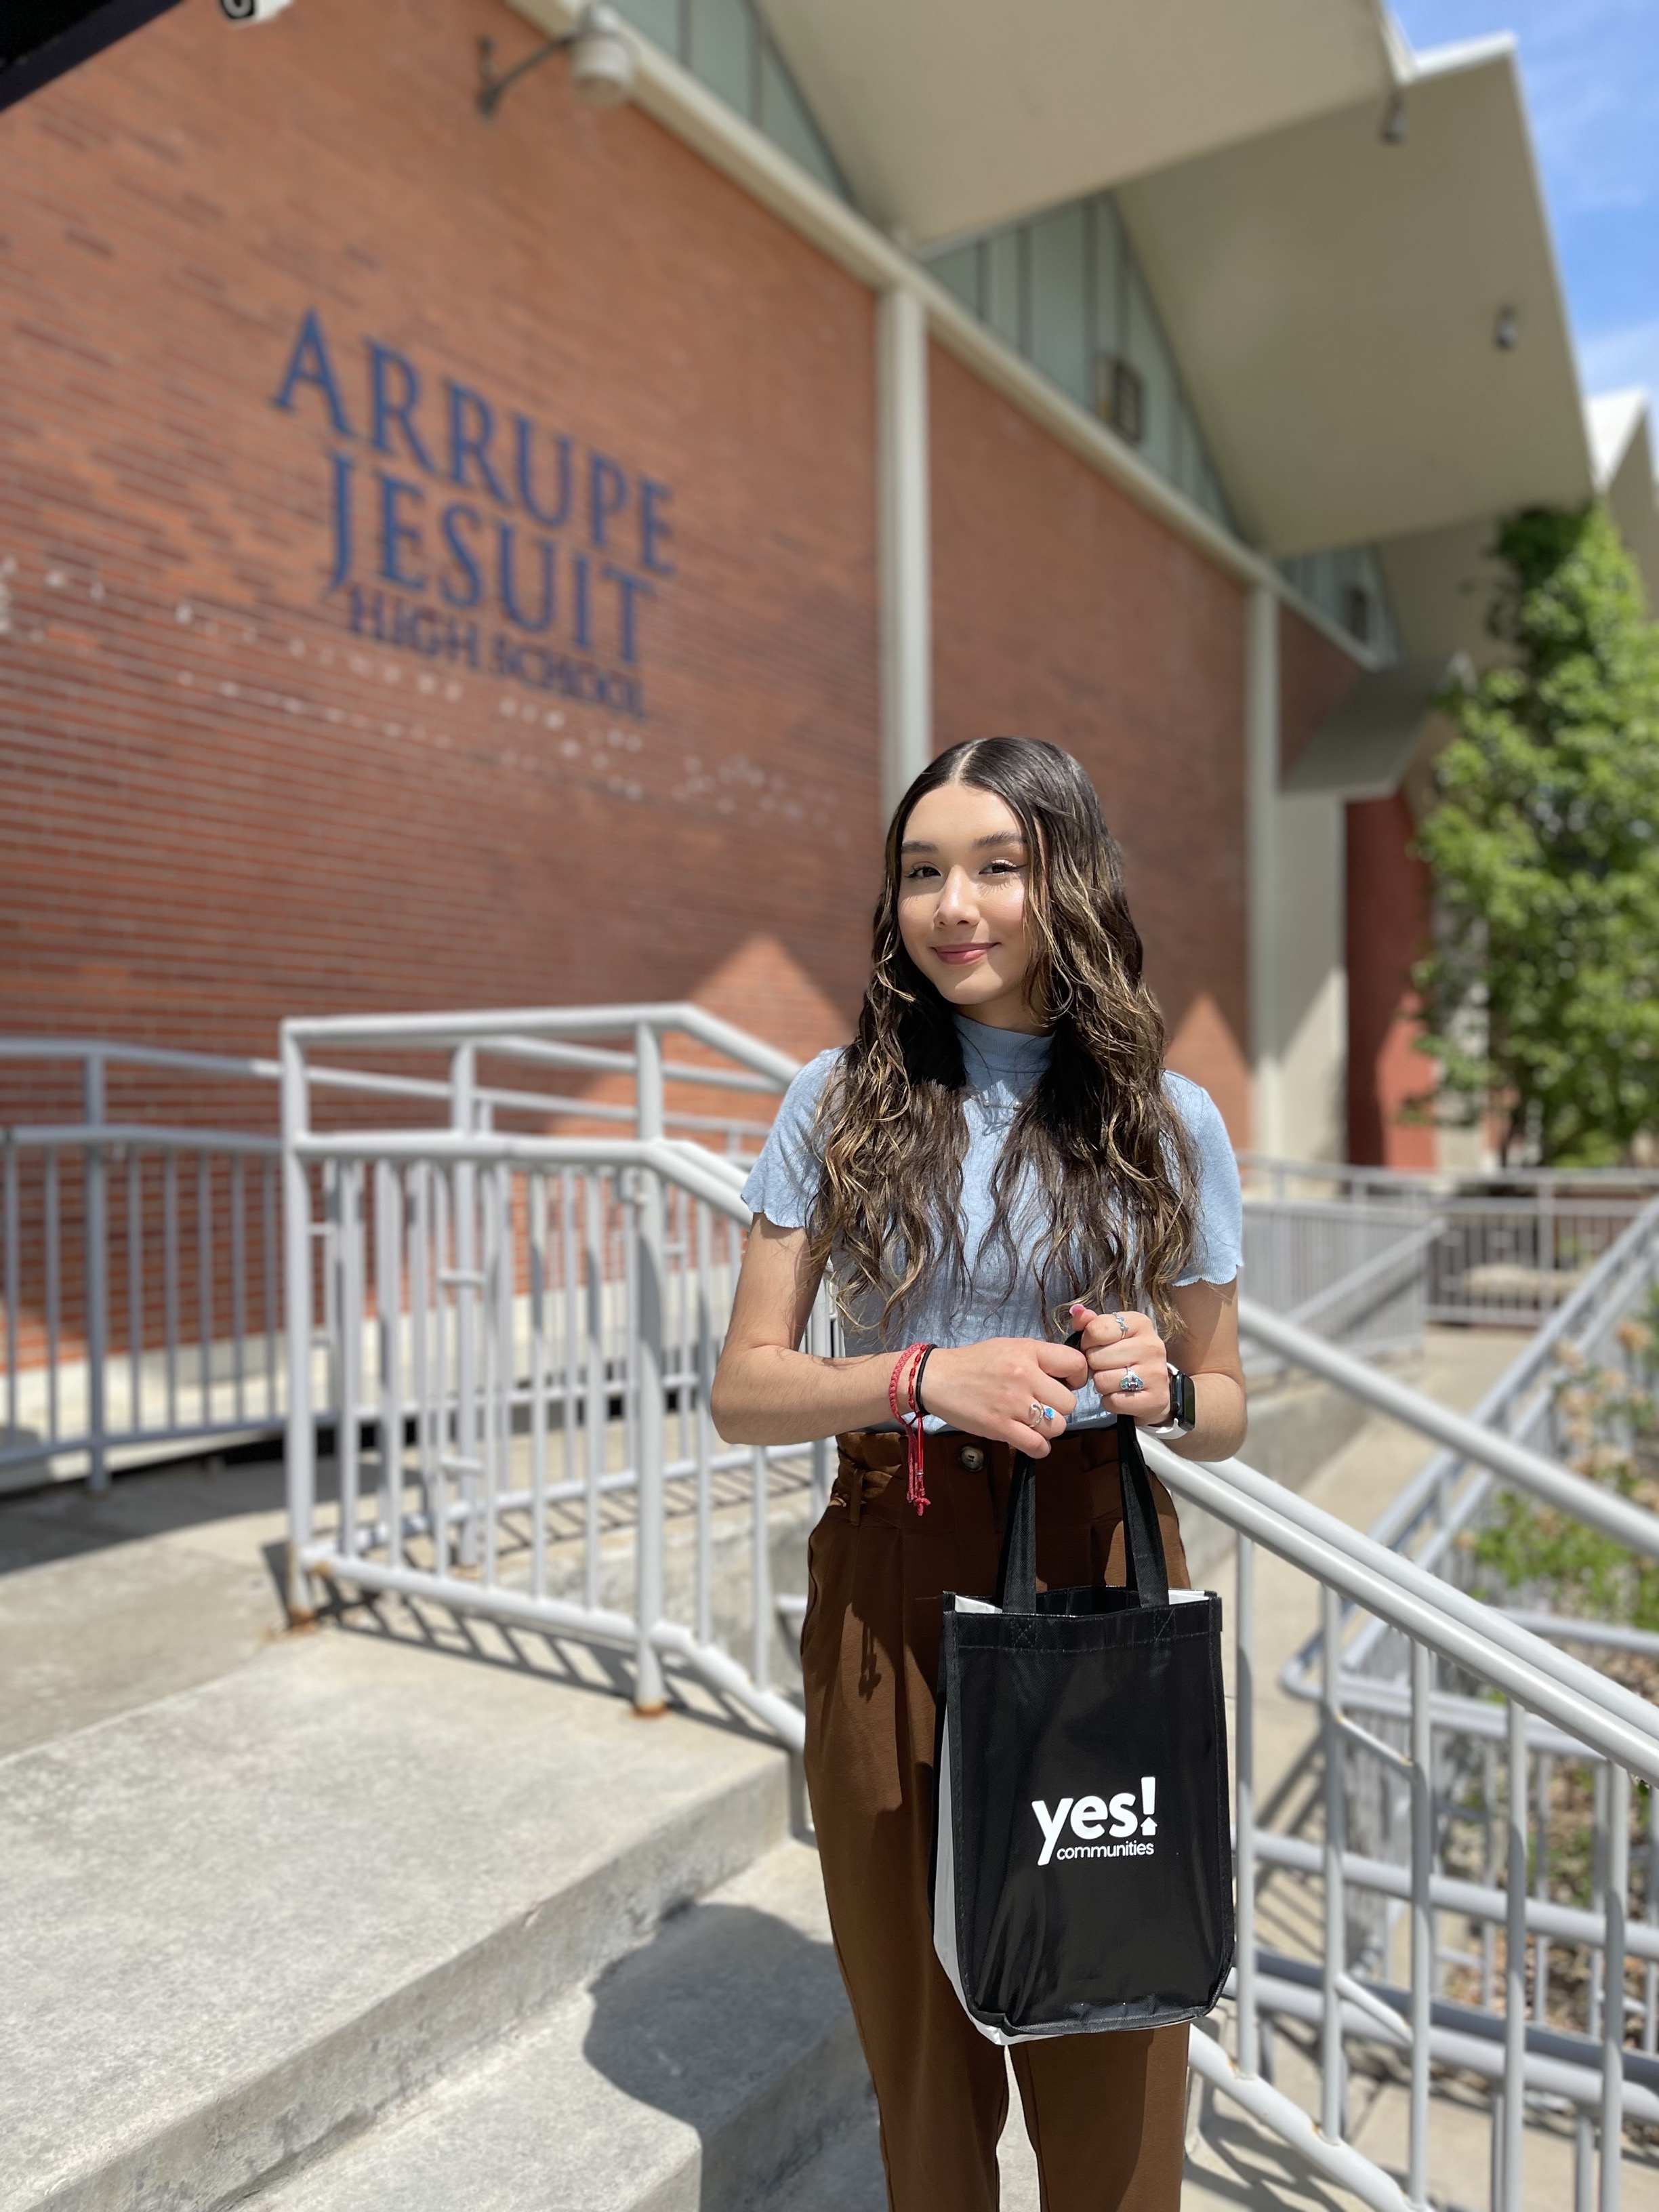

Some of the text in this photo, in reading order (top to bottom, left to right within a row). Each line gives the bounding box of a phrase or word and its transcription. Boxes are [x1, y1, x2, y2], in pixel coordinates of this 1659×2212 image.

[274, 313, 672, 575] ARRUPE
[328, 447, 655, 664] JESUIT
[347, 587, 479, 668] HIGH
[1031, 1776, 1158, 1866] yes!
[1057, 1840, 1154, 1860] communities
